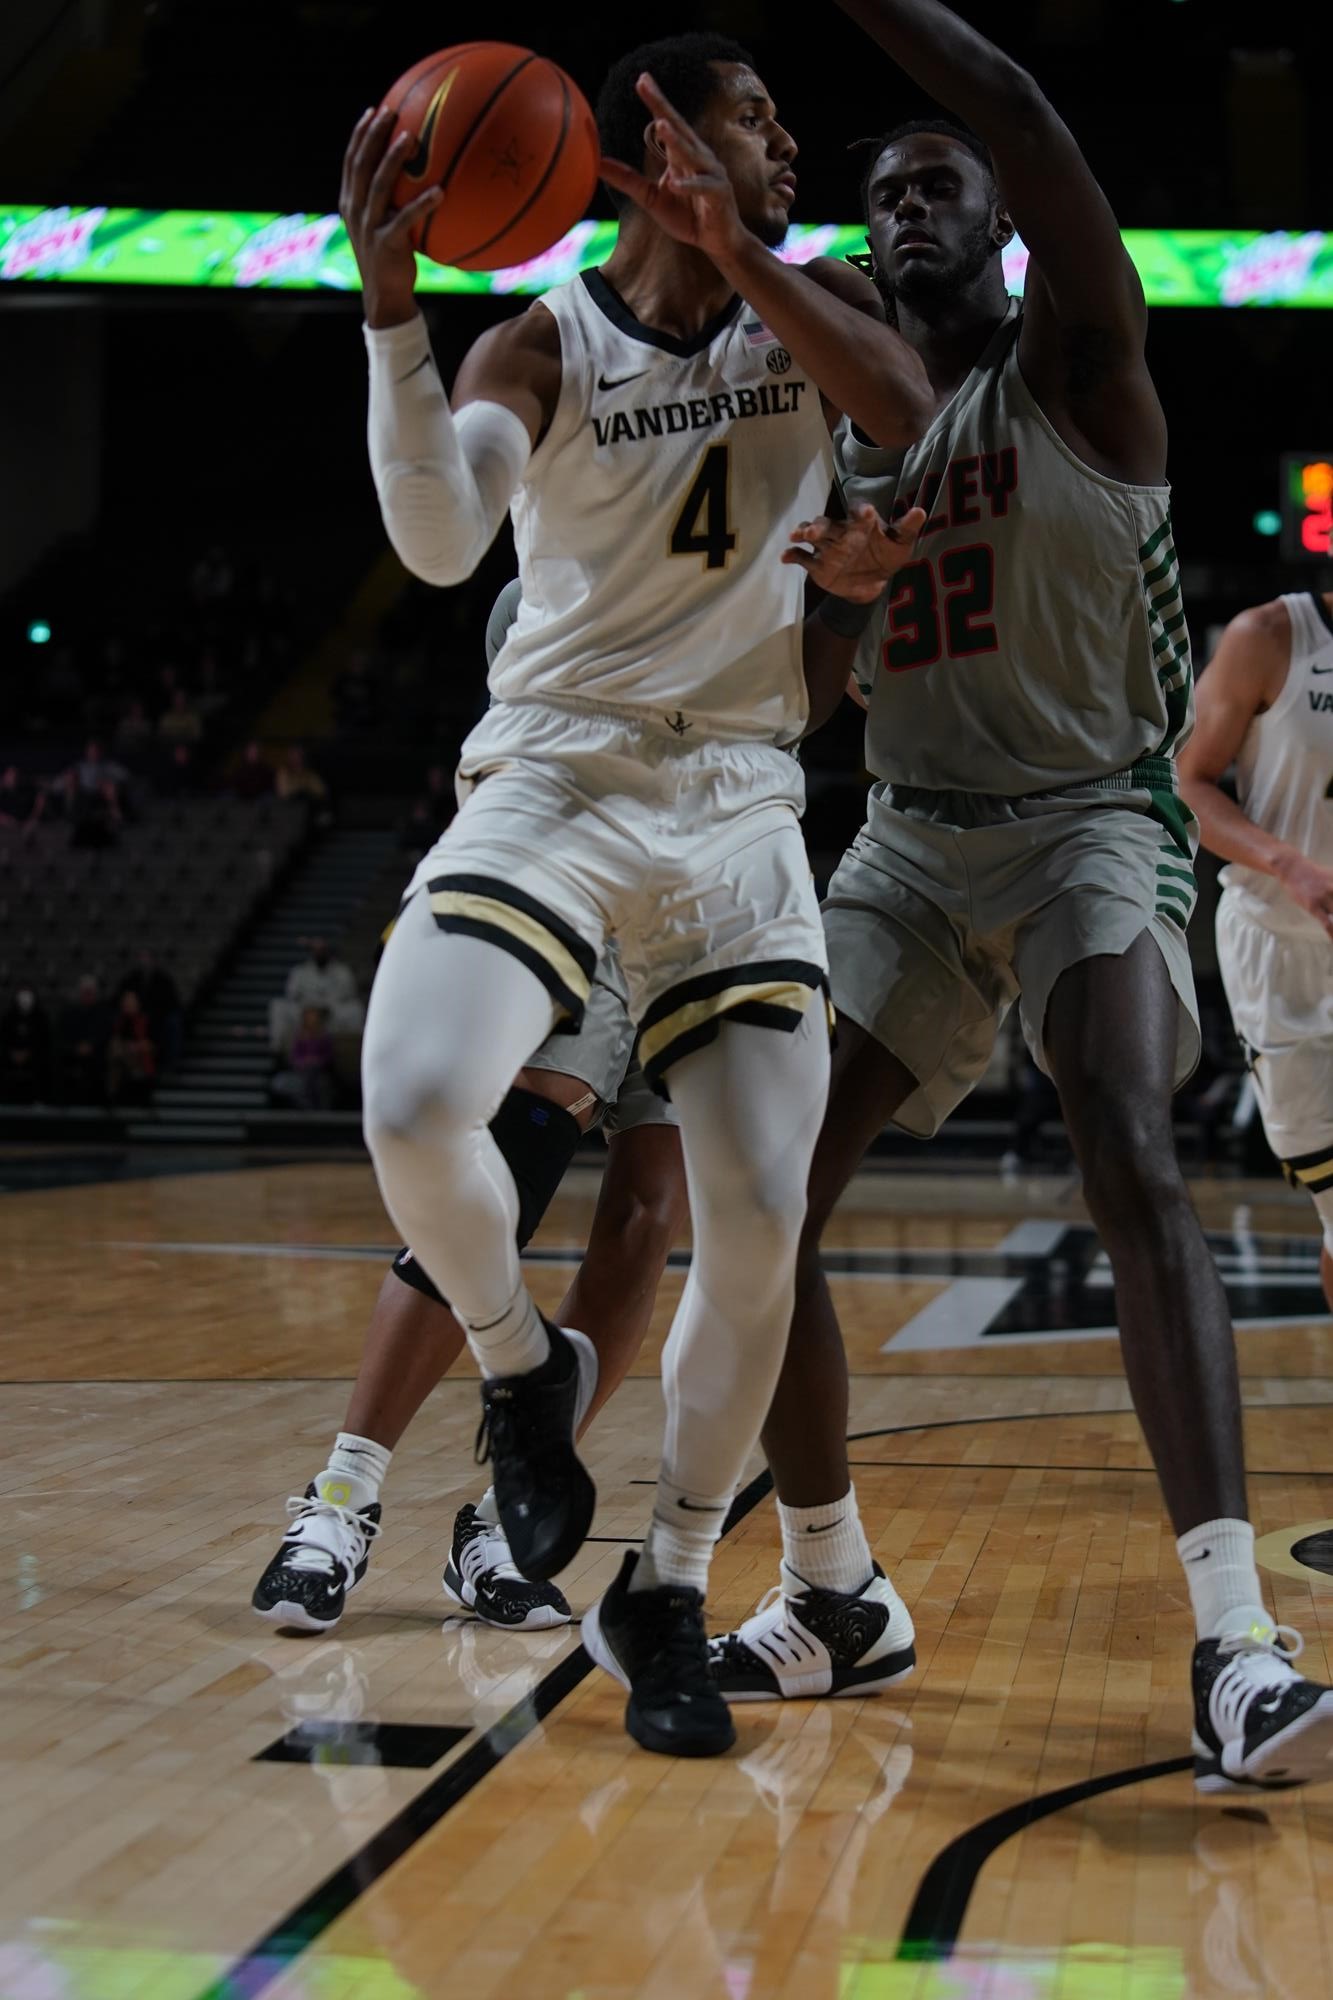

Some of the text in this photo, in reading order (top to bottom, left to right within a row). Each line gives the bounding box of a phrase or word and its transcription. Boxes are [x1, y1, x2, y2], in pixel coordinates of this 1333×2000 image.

[766, 348, 791, 375] SEC
[592, 382, 805, 446] VANDERBILT
[667, 438, 739, 572] 4
[891, 447, 1018, 538] LEY
[883, 543, 999, 672] 32
